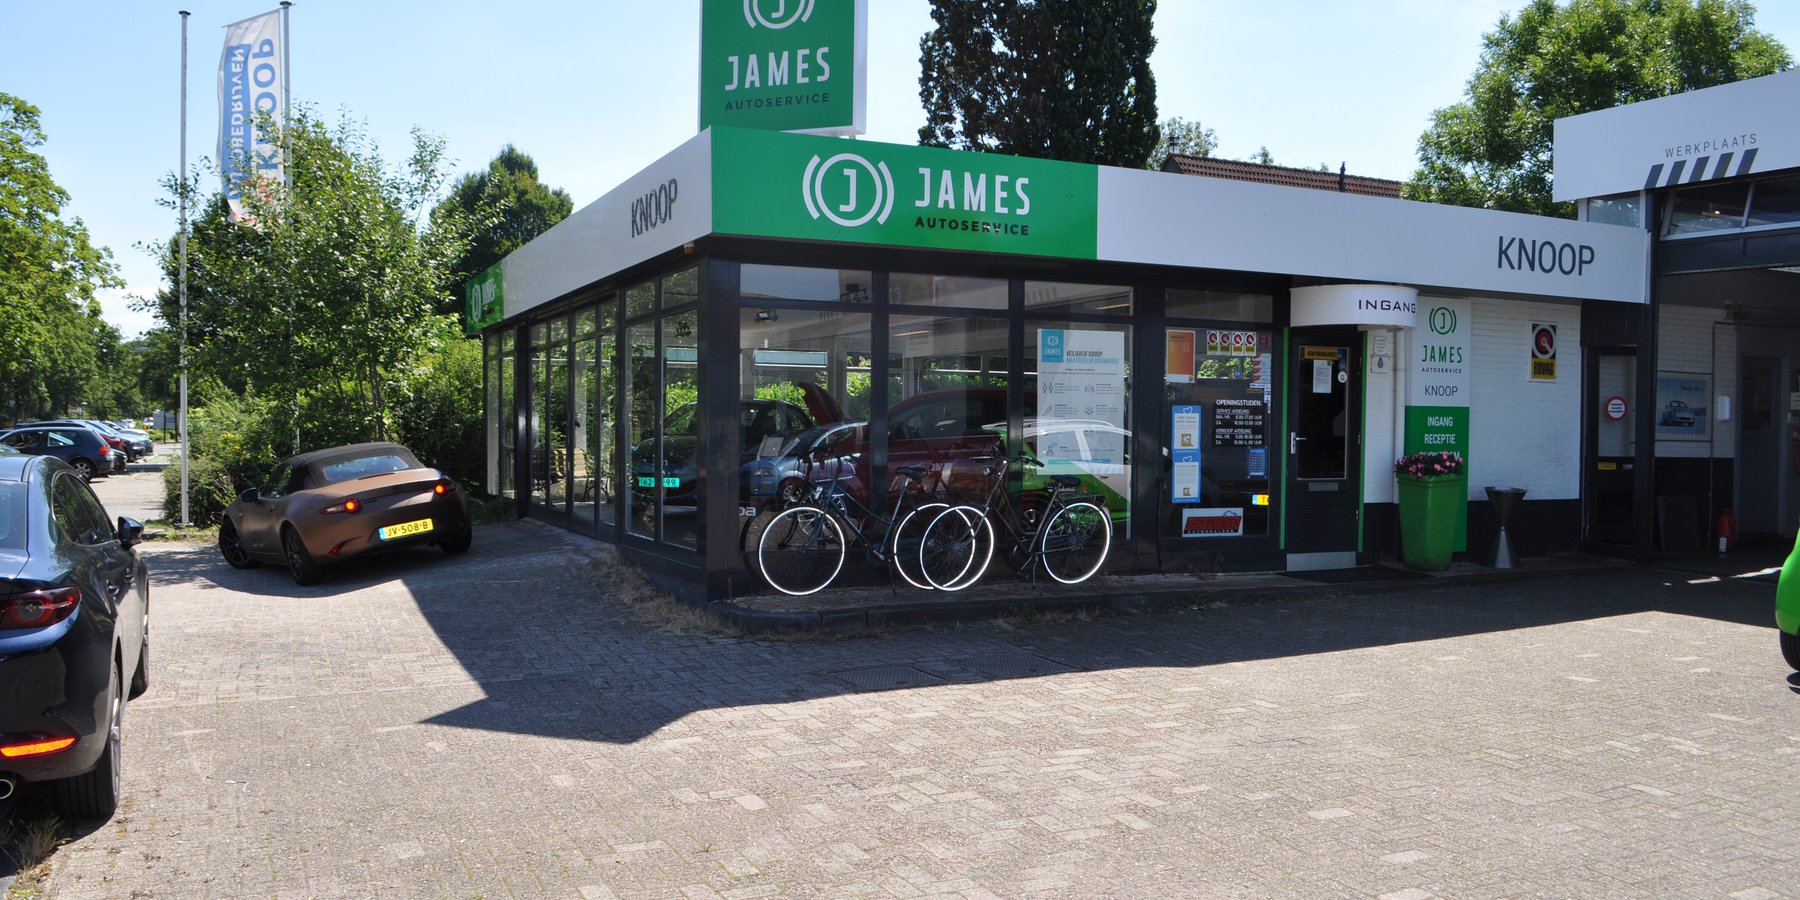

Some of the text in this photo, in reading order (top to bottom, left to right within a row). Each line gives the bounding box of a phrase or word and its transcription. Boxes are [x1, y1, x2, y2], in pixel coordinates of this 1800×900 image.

[724, 46, 831, 91] JAMES
[724, 93, 830, 111] AUTOSERVICE
[1664, 133, 1758, 159] WERKPLAATS
[915, 167, 1031, 216] JAMES
[631, 178, 678, 239] KNOOP
[914, 216, 1030, 236] AUTOSERVICE
[1497, 235, 1596, 276] KNOOP
[1358, 299, 1417, 314] INGANG
[1421, 345, 1463, 364] JAMES
[1533, 361, 1555, 377] BOVAG
[1424, 385, 1458, 397] KNOOP
[1427, 416, 1453, 427] INGANG
[1424, 433, 1456, 445] RECEPTIE
[386, 520, 429, 537] JV-508-B
